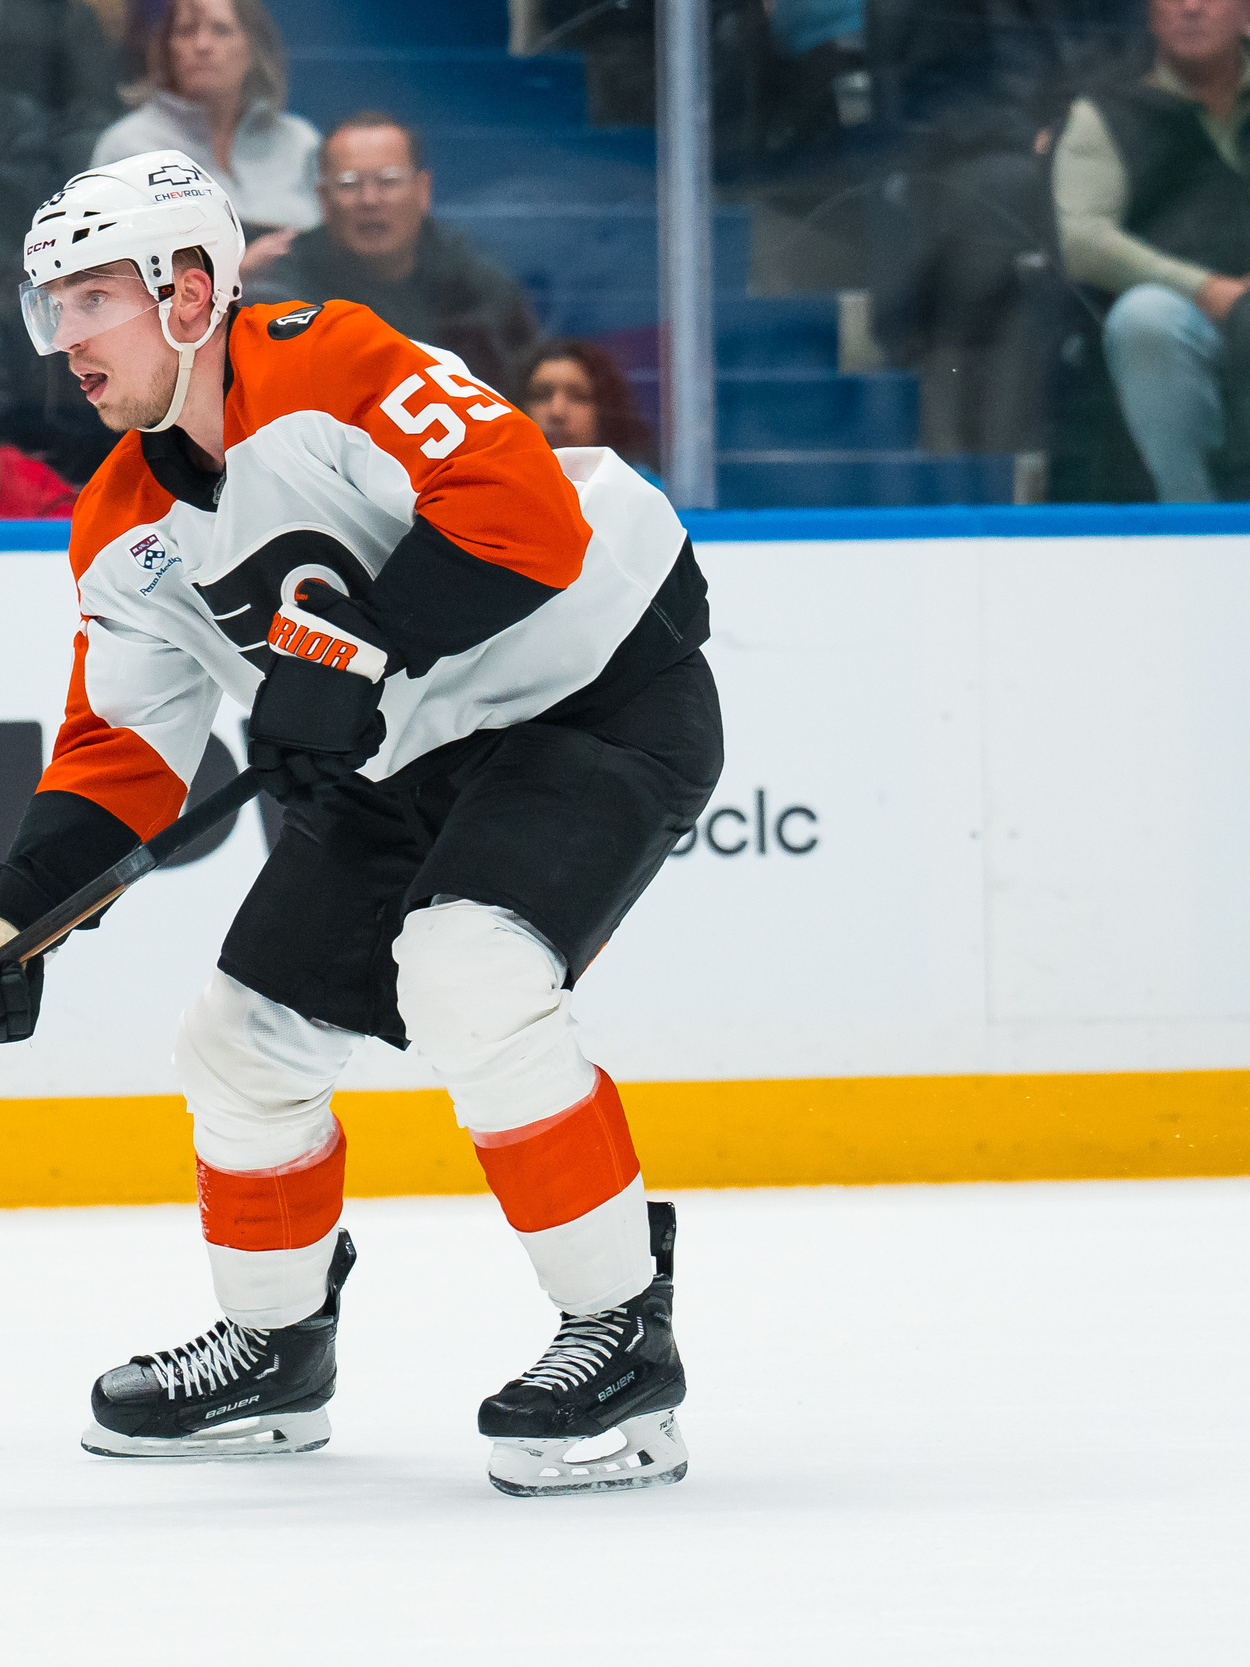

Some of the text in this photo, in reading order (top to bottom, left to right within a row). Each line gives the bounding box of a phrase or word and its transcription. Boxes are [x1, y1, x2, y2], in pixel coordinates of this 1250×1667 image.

[26, 238, 57, 256] CCM
[379, 364, 512, 460] 55
[139, 577, 159, 597] Penn
